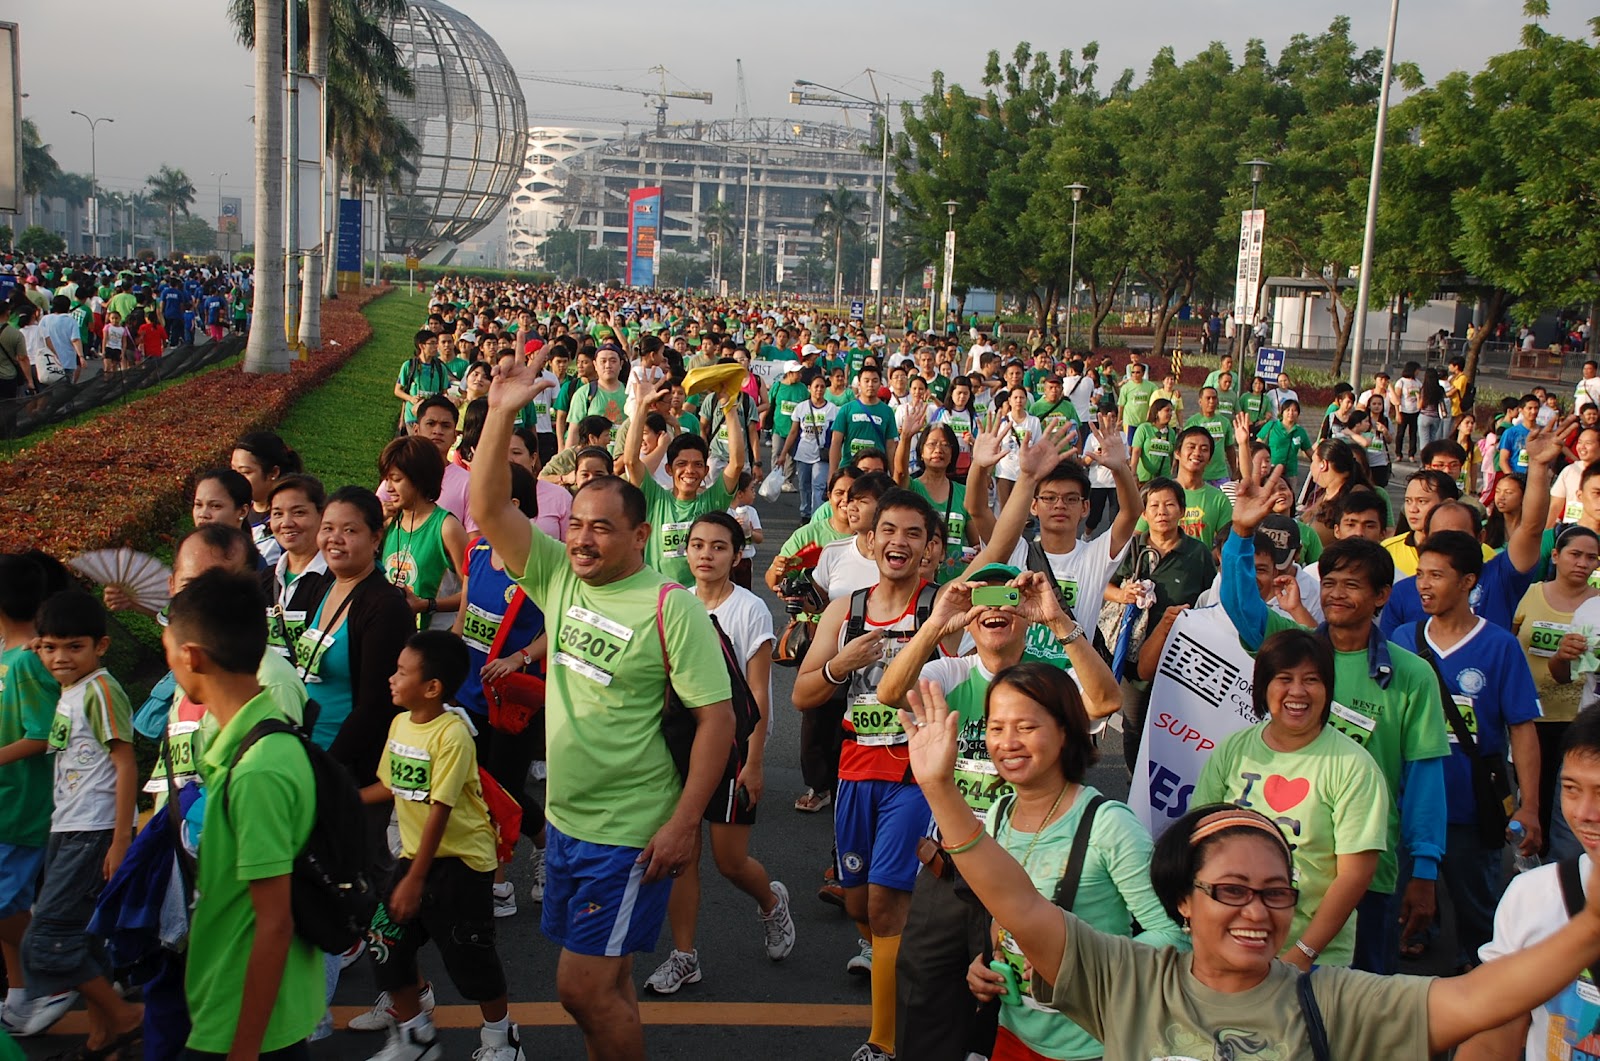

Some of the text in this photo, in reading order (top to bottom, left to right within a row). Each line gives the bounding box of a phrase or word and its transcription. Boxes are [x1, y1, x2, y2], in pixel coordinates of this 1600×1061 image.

[464, 616, 497, 640] 1532
[559, 624, 622, 663] 56207
[1153, 712, 1215, 752] SUPP
[1233, 772, 1262, 807] I
